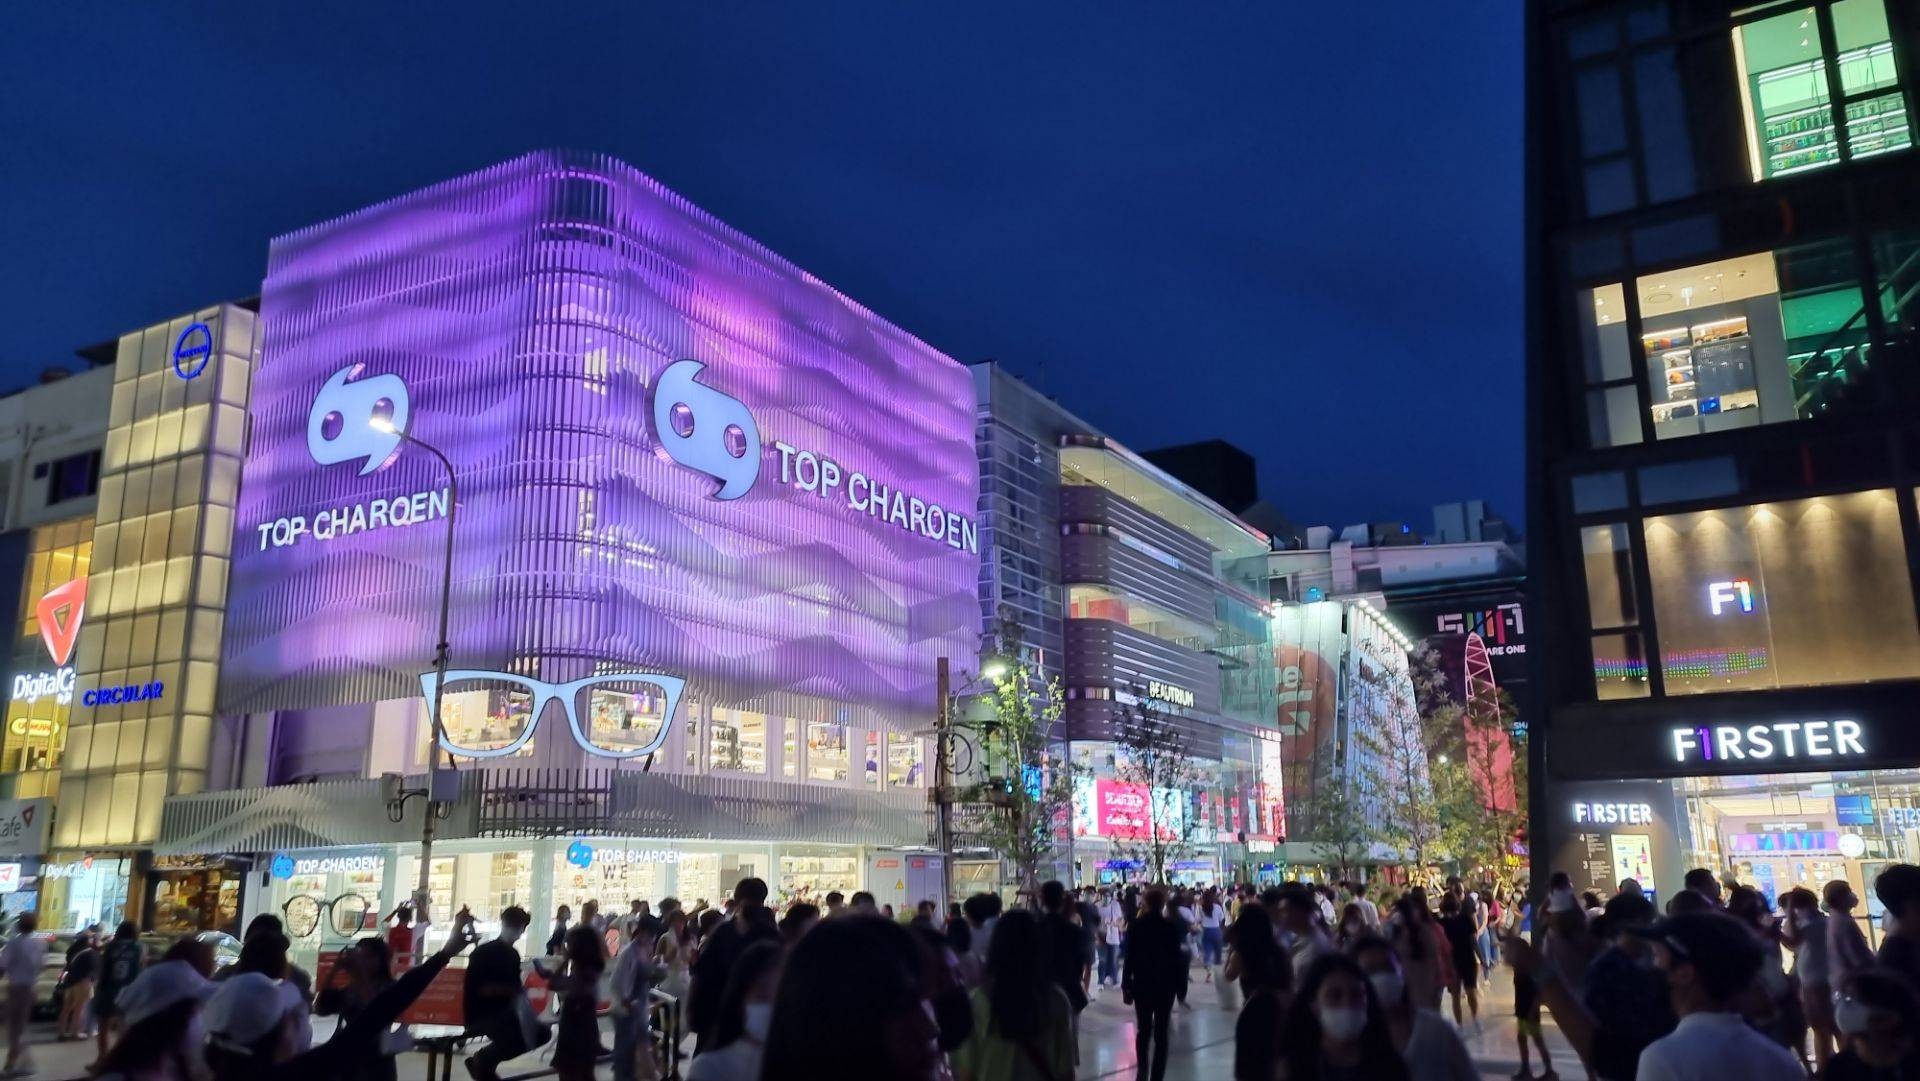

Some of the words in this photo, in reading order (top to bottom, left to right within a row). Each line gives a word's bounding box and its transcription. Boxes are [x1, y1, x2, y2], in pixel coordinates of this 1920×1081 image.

[775, 441, 840, 497] TOP
[848, 472, 977, 554] CHAROEN
[258, 516, 306, 550] TOP
[313, 488, 449, 540] CHAROEN
[1709, 580, 1753, 616] F1
[1506, 645, 1526, 654] ONE
[82, 681, 164, 708] CIRCULAR
[1149, 681, 1194, 708] BEAUTRIUM
[297, 860, 319, 873] TOP
[322, 856, 376, 872] CHAROEN
[598, 848, 621, 863] TOP
[626, 850, 682, 864] CHAROEN
